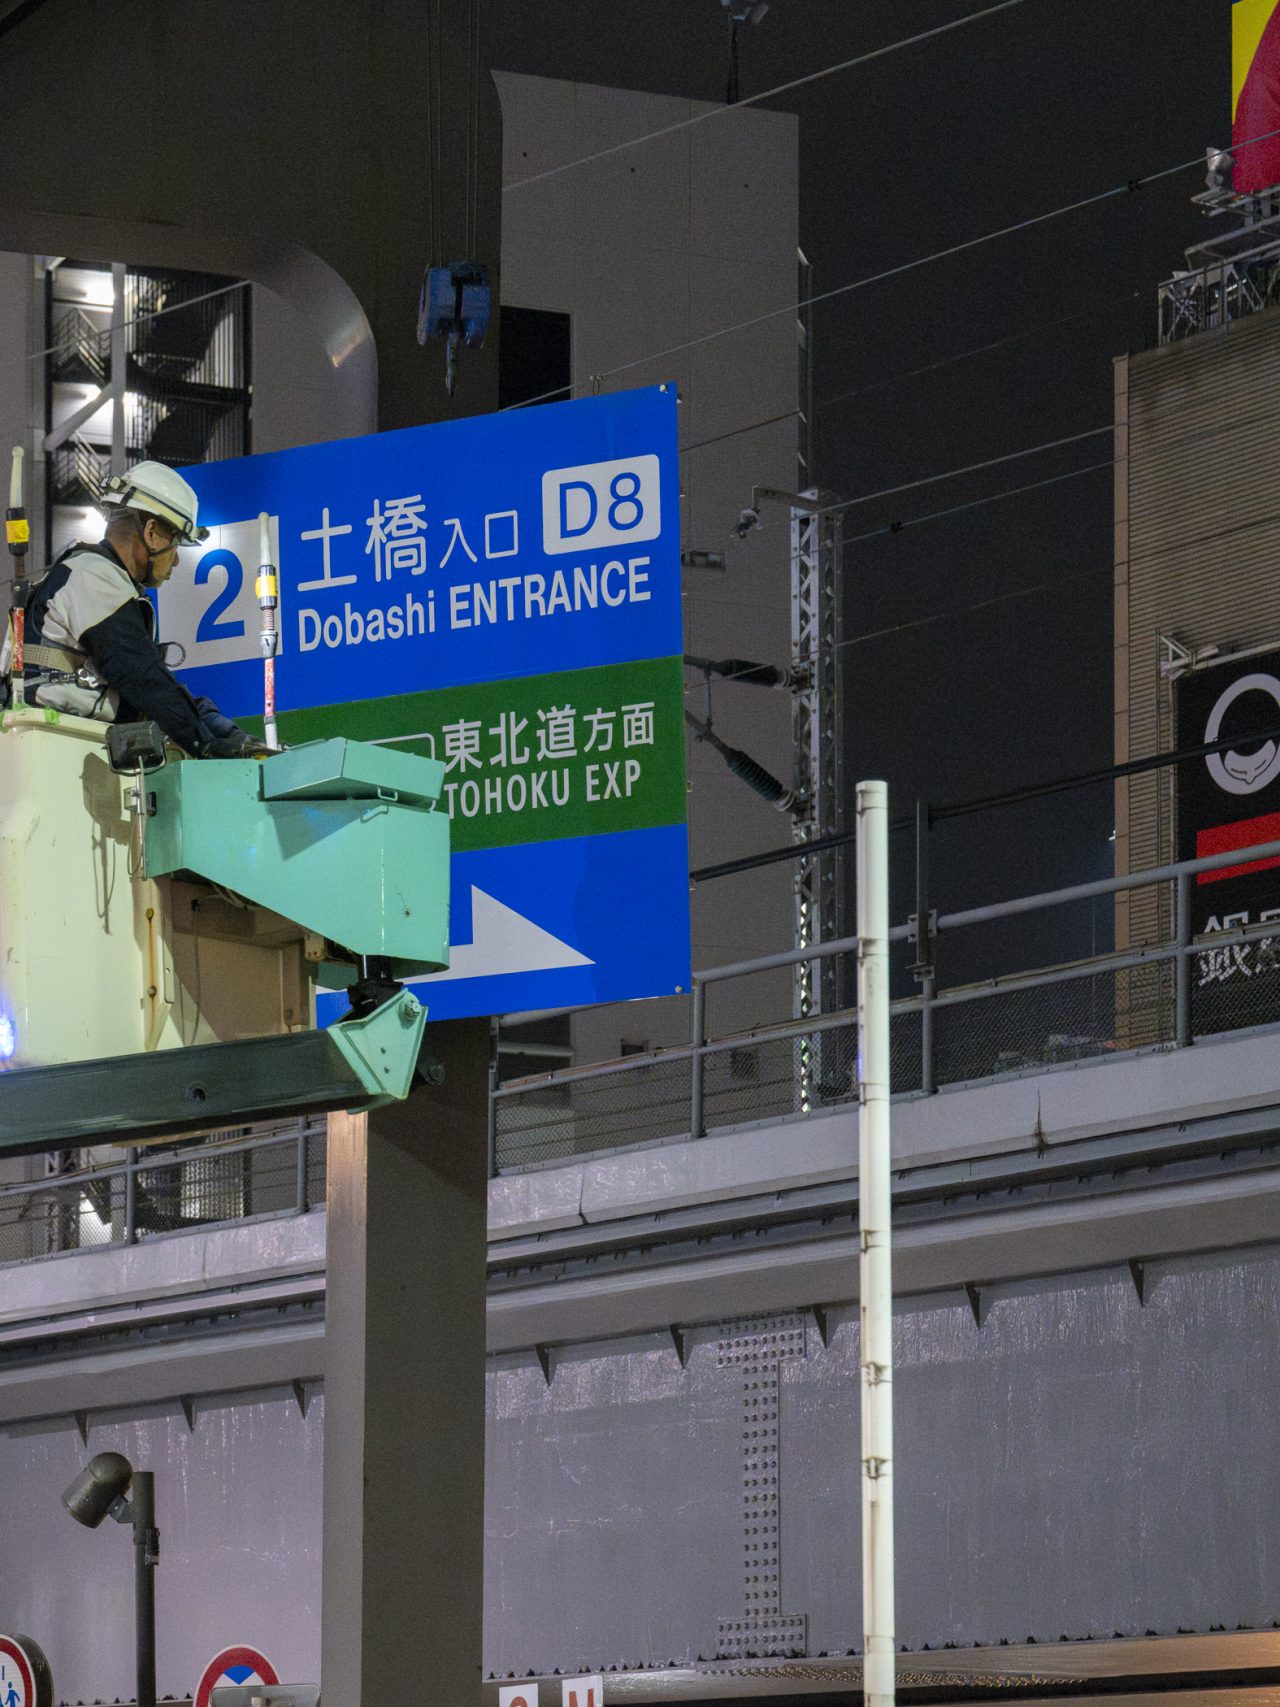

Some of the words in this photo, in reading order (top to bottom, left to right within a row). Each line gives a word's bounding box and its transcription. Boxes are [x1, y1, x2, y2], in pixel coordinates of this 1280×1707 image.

[559, 472, 645, 539] D8
[195, 548, 246, 644] 2
[298, 589, 436, 652] Dobashi
[449, 556, 652, 630] ENTRANCE
[441, 701, 655, 774] 東北道方面
[443, 768, 570, 820] TOHOKU
[586, 759, 641, 802] EXP
